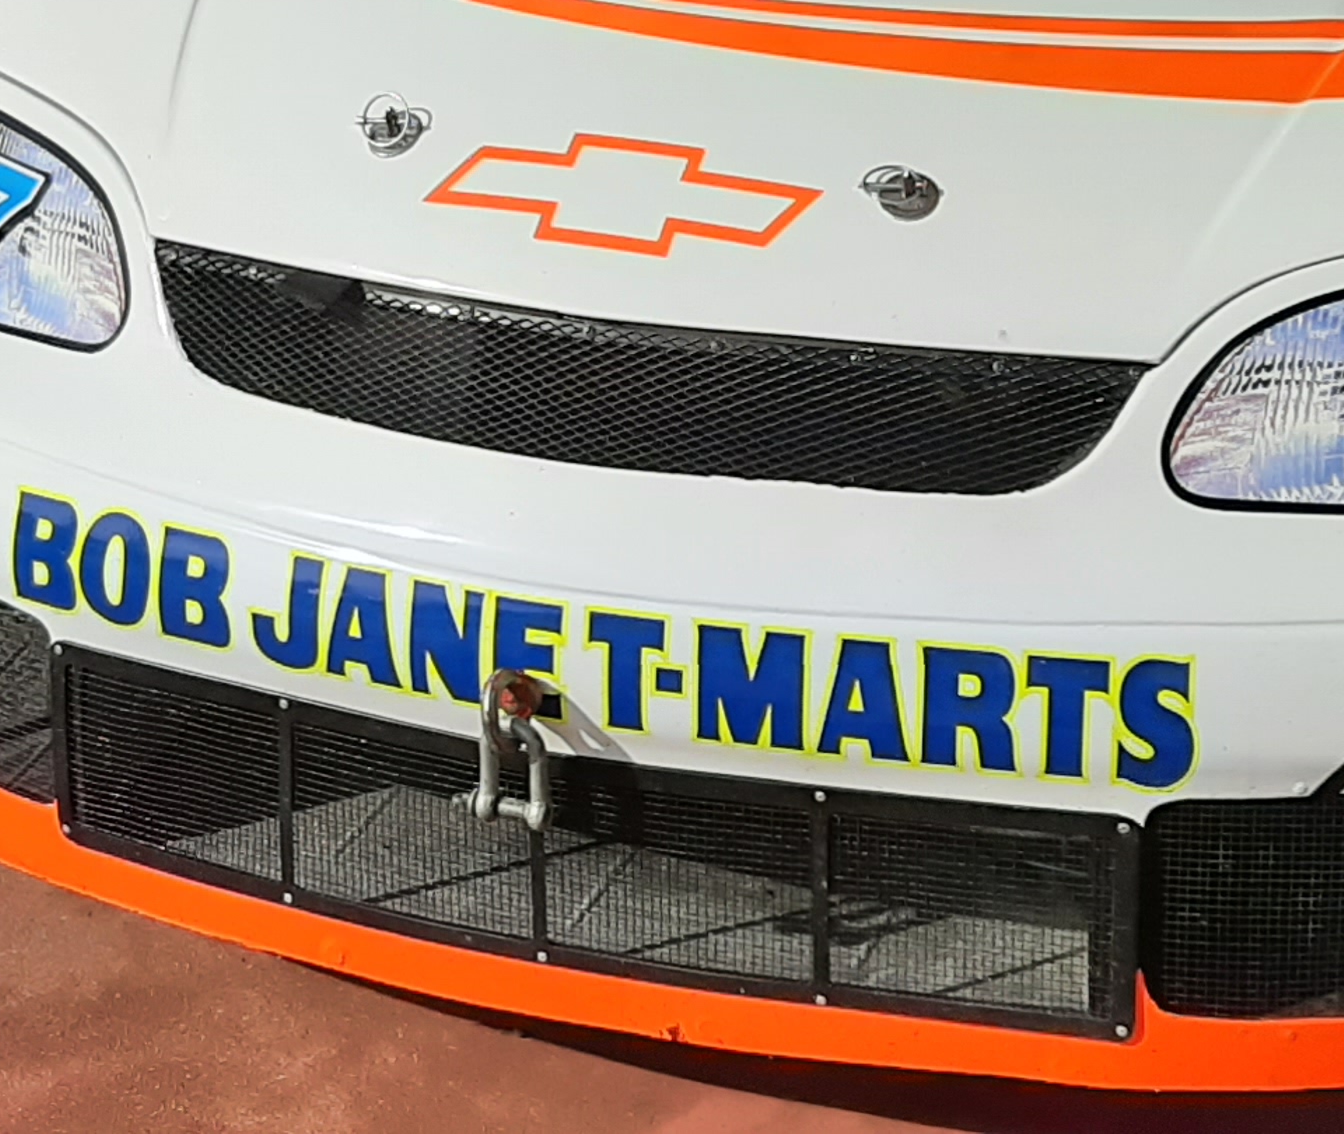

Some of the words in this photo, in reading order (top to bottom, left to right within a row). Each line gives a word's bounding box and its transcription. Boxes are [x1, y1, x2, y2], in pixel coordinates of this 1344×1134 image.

[12, 484, 236, 651] BOB
[248, 549, 570, 724] JANE
[583, 605, 1200, 795] T-MARTS
